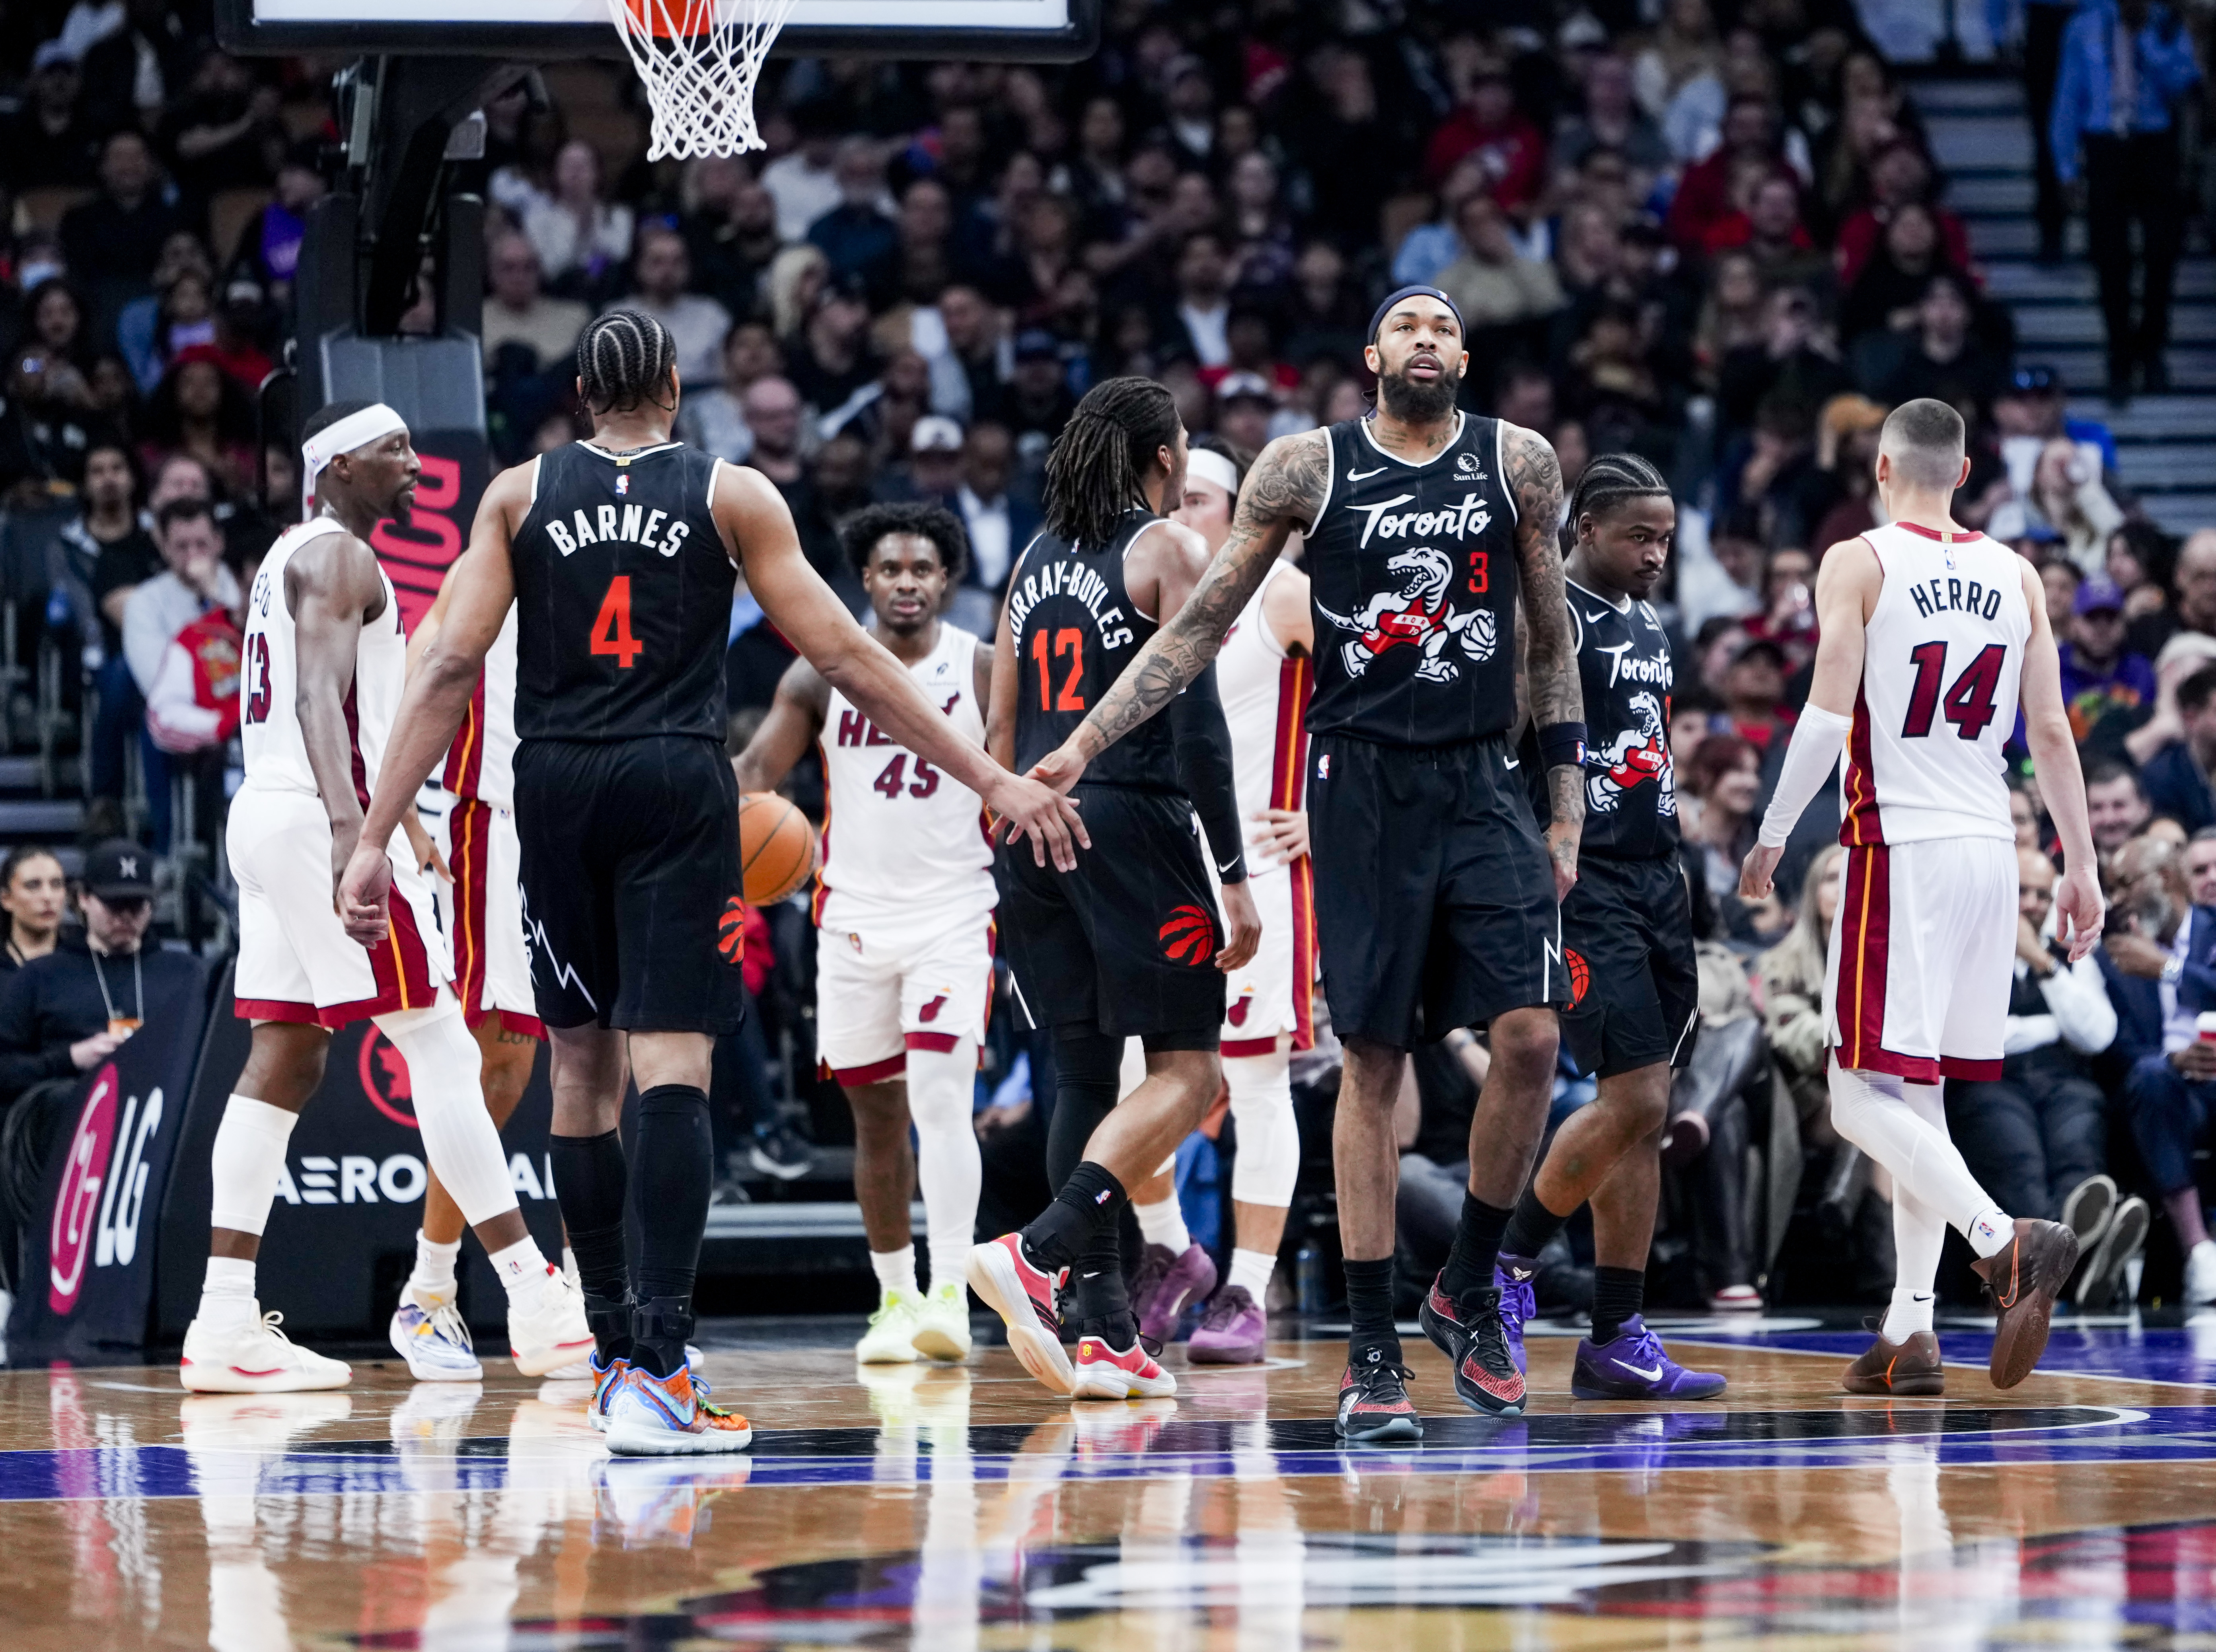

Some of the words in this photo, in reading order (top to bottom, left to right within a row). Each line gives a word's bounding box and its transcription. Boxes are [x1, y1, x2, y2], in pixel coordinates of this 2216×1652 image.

[1471, 472, 1488, 480] Life
[545, 504, 690, 557] BARNES
[1345, 492, 1492, 550] Toronto
[1468, 552, 1488, 593] 3
[1909, 578, 2002, 621] HERRO
[590, 576, 643, 668] 4
[245, 632, 272, 725] 13
[1032, 628, 1085, 711] 12
[1594, 640, 1673, 691] Toronto
[1901, 641, 2008, 741] 14
[874, 753, 941, 799] 45
[95, 1086, 164, 1267] LG
